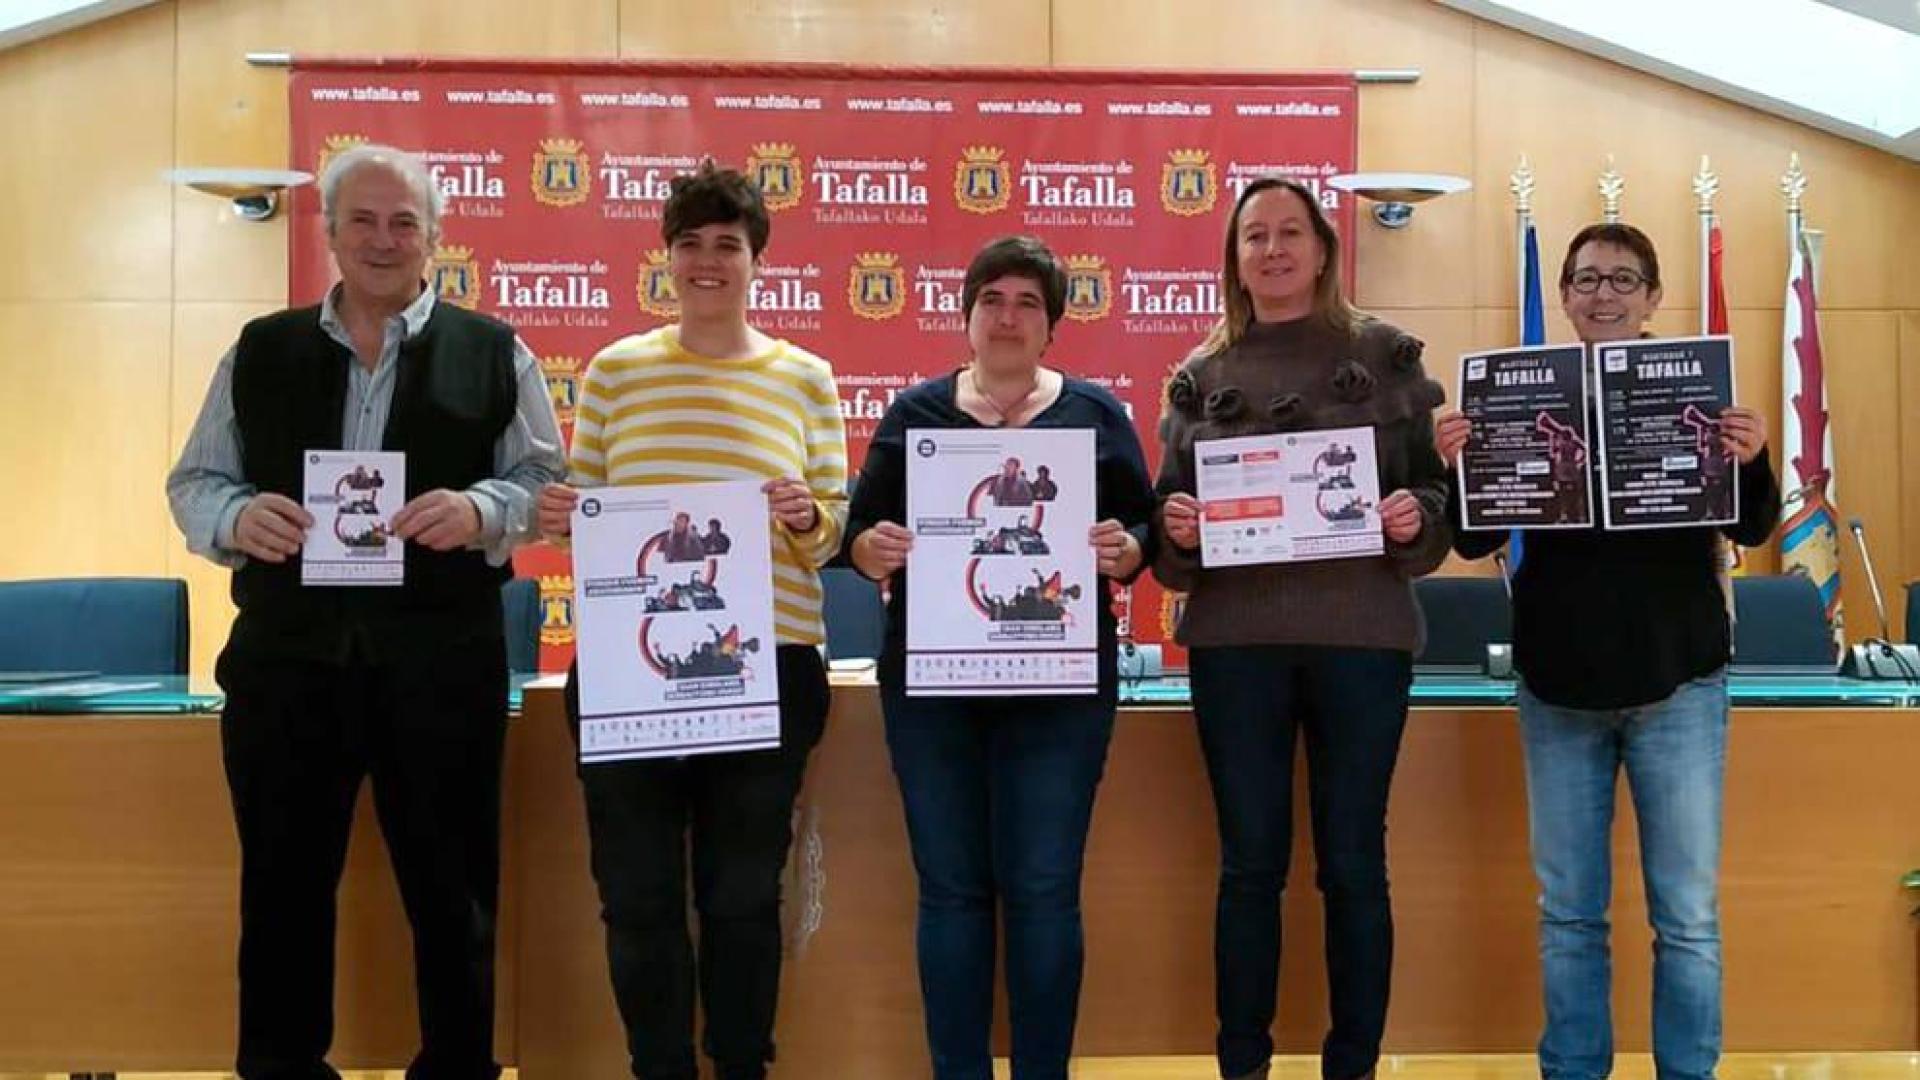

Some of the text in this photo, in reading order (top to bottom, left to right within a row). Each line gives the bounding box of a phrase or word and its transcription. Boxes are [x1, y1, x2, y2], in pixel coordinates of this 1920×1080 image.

[312, 87, 420, 102] www.tafalla.es
[447, 89, 556, 104] www.tafalla.es
[581, 93, 689, 108] www.tafalla.es
[715, 94, 822, 110] www.tafalla.es
[848, 97, 953, 113] www.tafalla.es
[977, 99, 1082, 115] www.tafalla.es
[1108, 102, 1211, 116] www.tafalla.es
[1236, 102, 1340, 117] www.tafalla.es
[485, 149, 504, 163] de
[603, 151, 697, 168] Ayuntamiento
[813, 156, 928, 172] Ayuntamiento de
[1022, 160, 1133, 175] Ayuntamiento de
[1321, 161, 1338, 175] de
[430, 166, 505, 198] falla
[601, 168, 690, 200] Tafa
[812, 172, 928, 205] Tafalla
[1020, 175, 1135, 208] Tafalla
[459, 201, 504, 217] Udala
[813, 208, 928, 224] Tafallako Udala
[1022, 211, 1134, 227] Tafallako Udala
[492, 259, 608, 274] Ayuntamiento de
[802, 263, 820, 277] de
[1123, 267, 1214, 282] Ayuntamiento
[491, 275, 609, 308] Tafalla
[747, 279, 823, 311] falla
[564, 312, 608, 327] Udala
[777, 316, 821, 331] Udala
[1122, 320, 1188, 334] Tafallako
[1494, 367, 1556, 387] TAFALLA
[1636, 360, 1704, 380] TAFALLA
